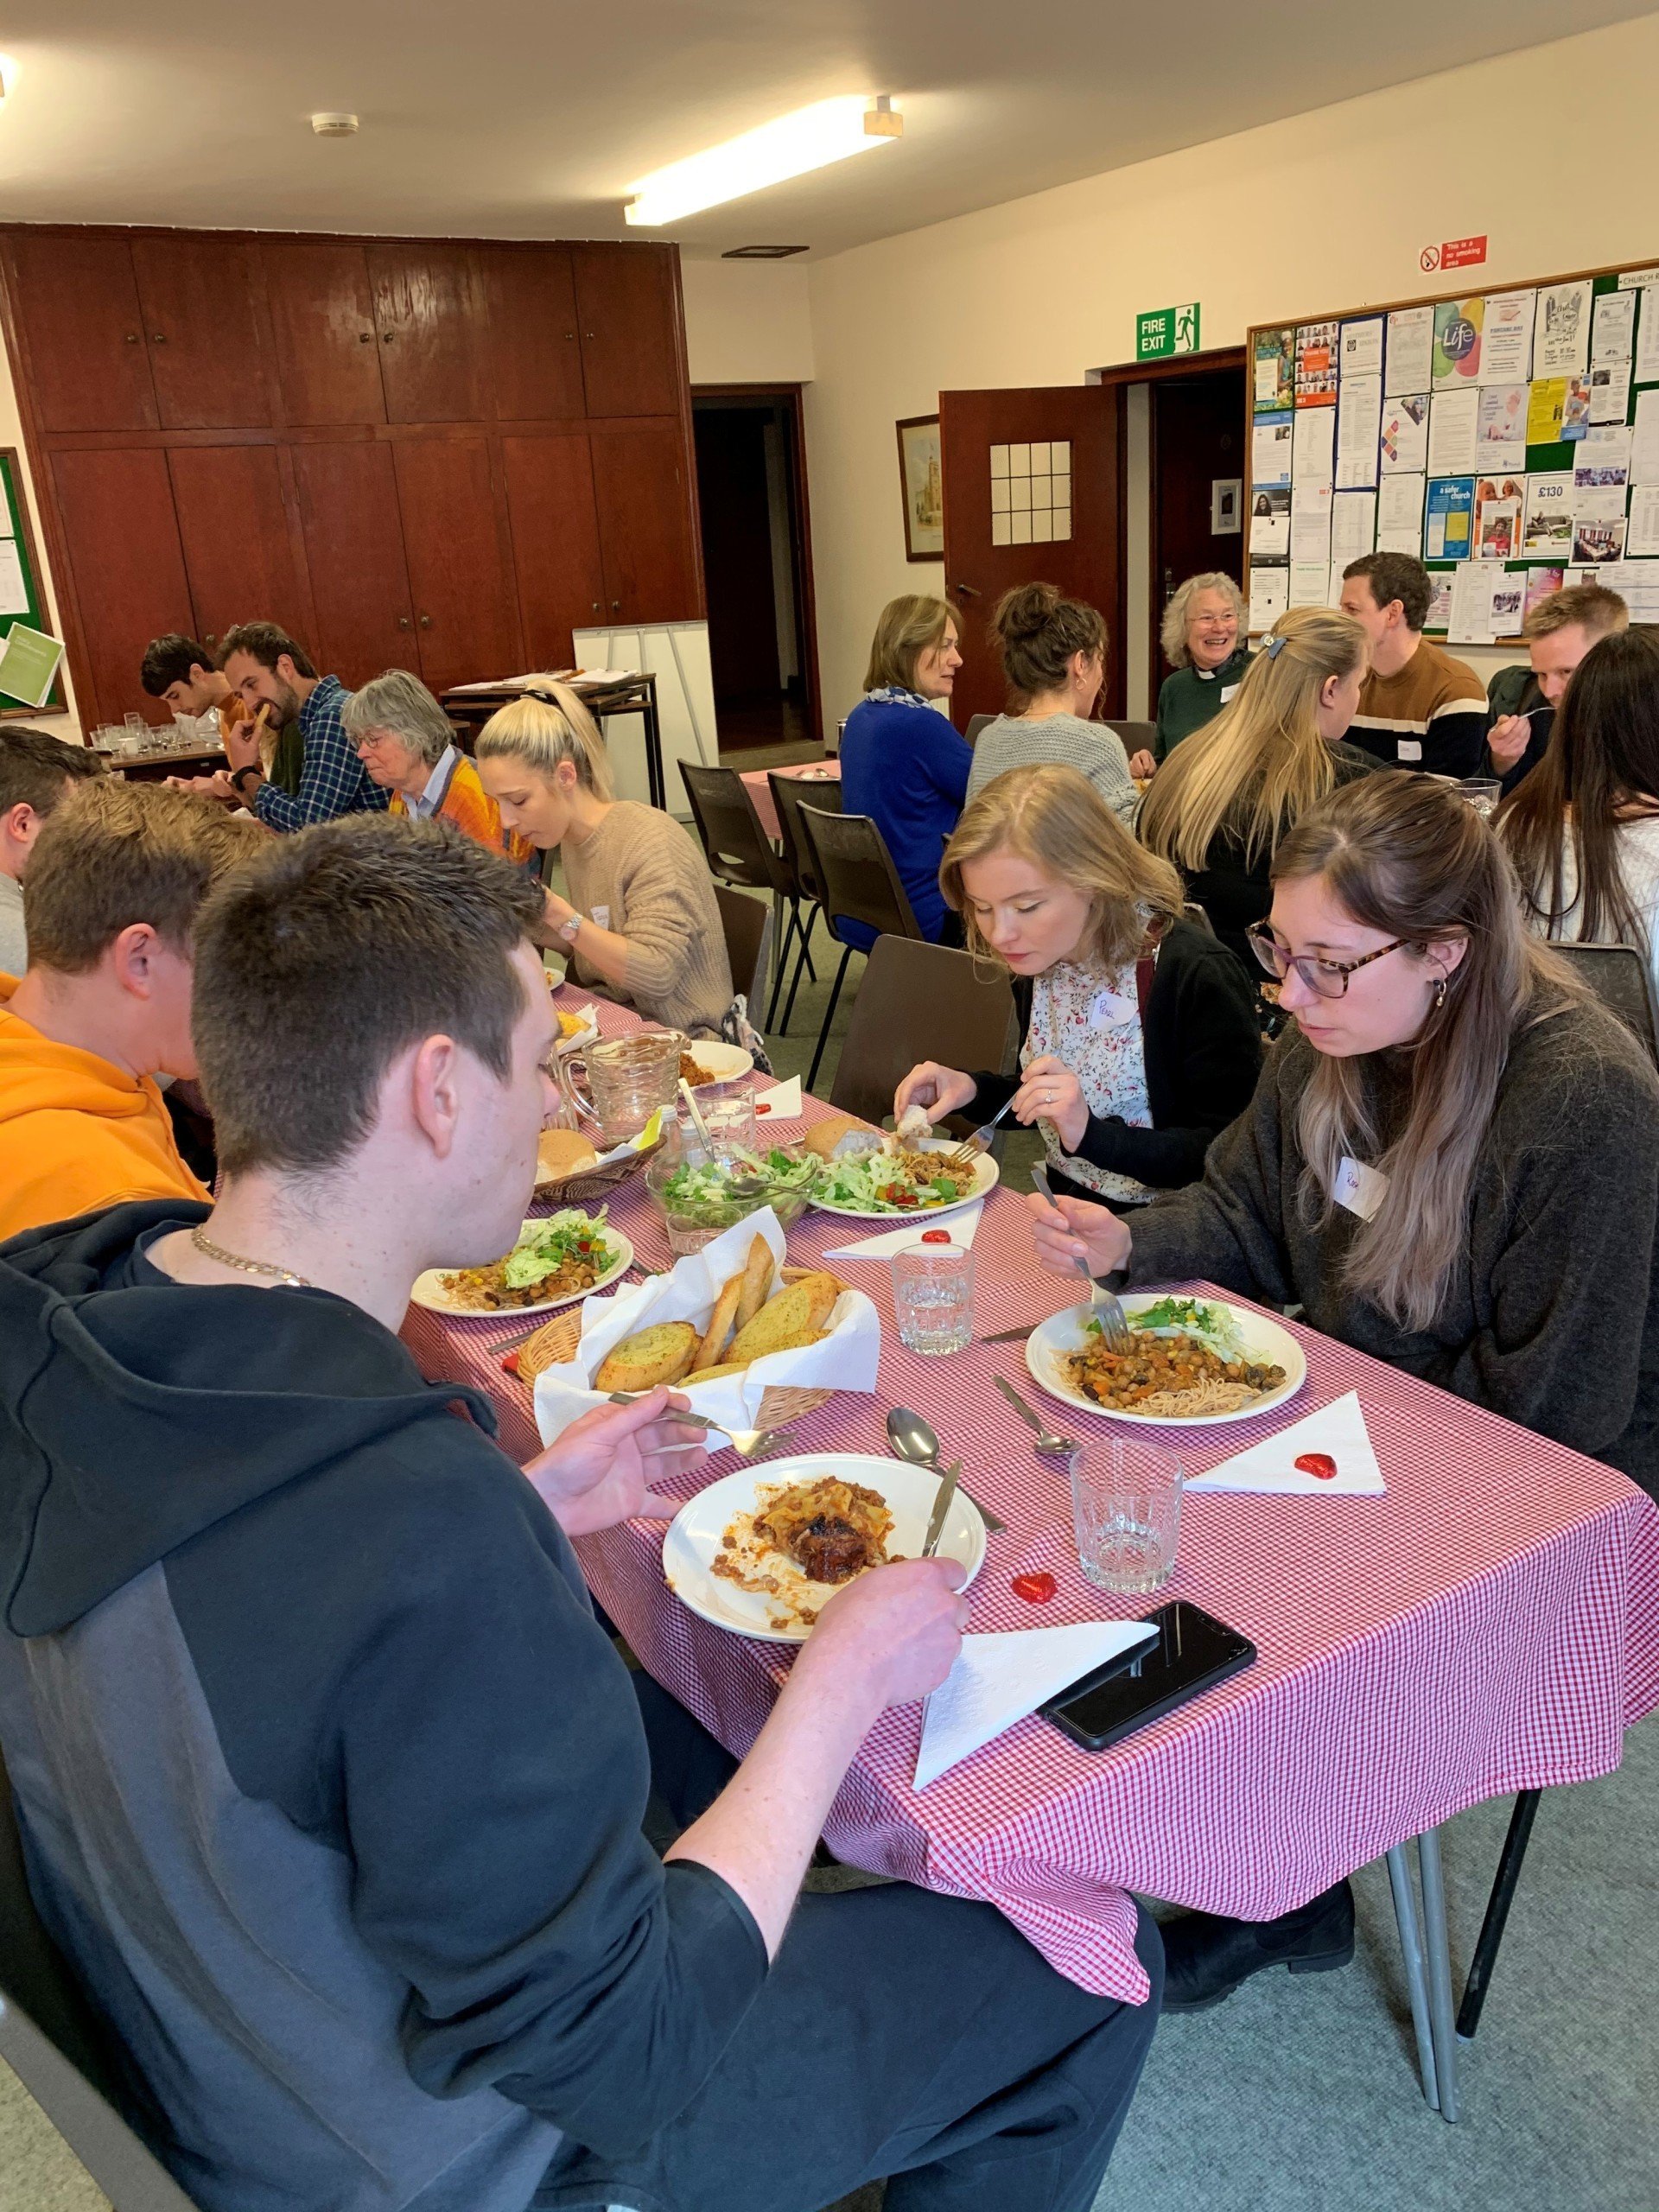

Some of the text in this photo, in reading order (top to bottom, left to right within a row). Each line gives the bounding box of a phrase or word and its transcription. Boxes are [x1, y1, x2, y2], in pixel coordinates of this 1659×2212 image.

[1456, 247, 1481, 257] smoking
[1624, 274, 1653, 284] CHURCH
[1142, 318, 1166, 334] FIRE
[1443, 323, 1473, 351] Life
[1142, 335, 1166, 352] EXIT
[1451, 491, 1471, 499] church
[1538, 486, 1562, 498] £130
